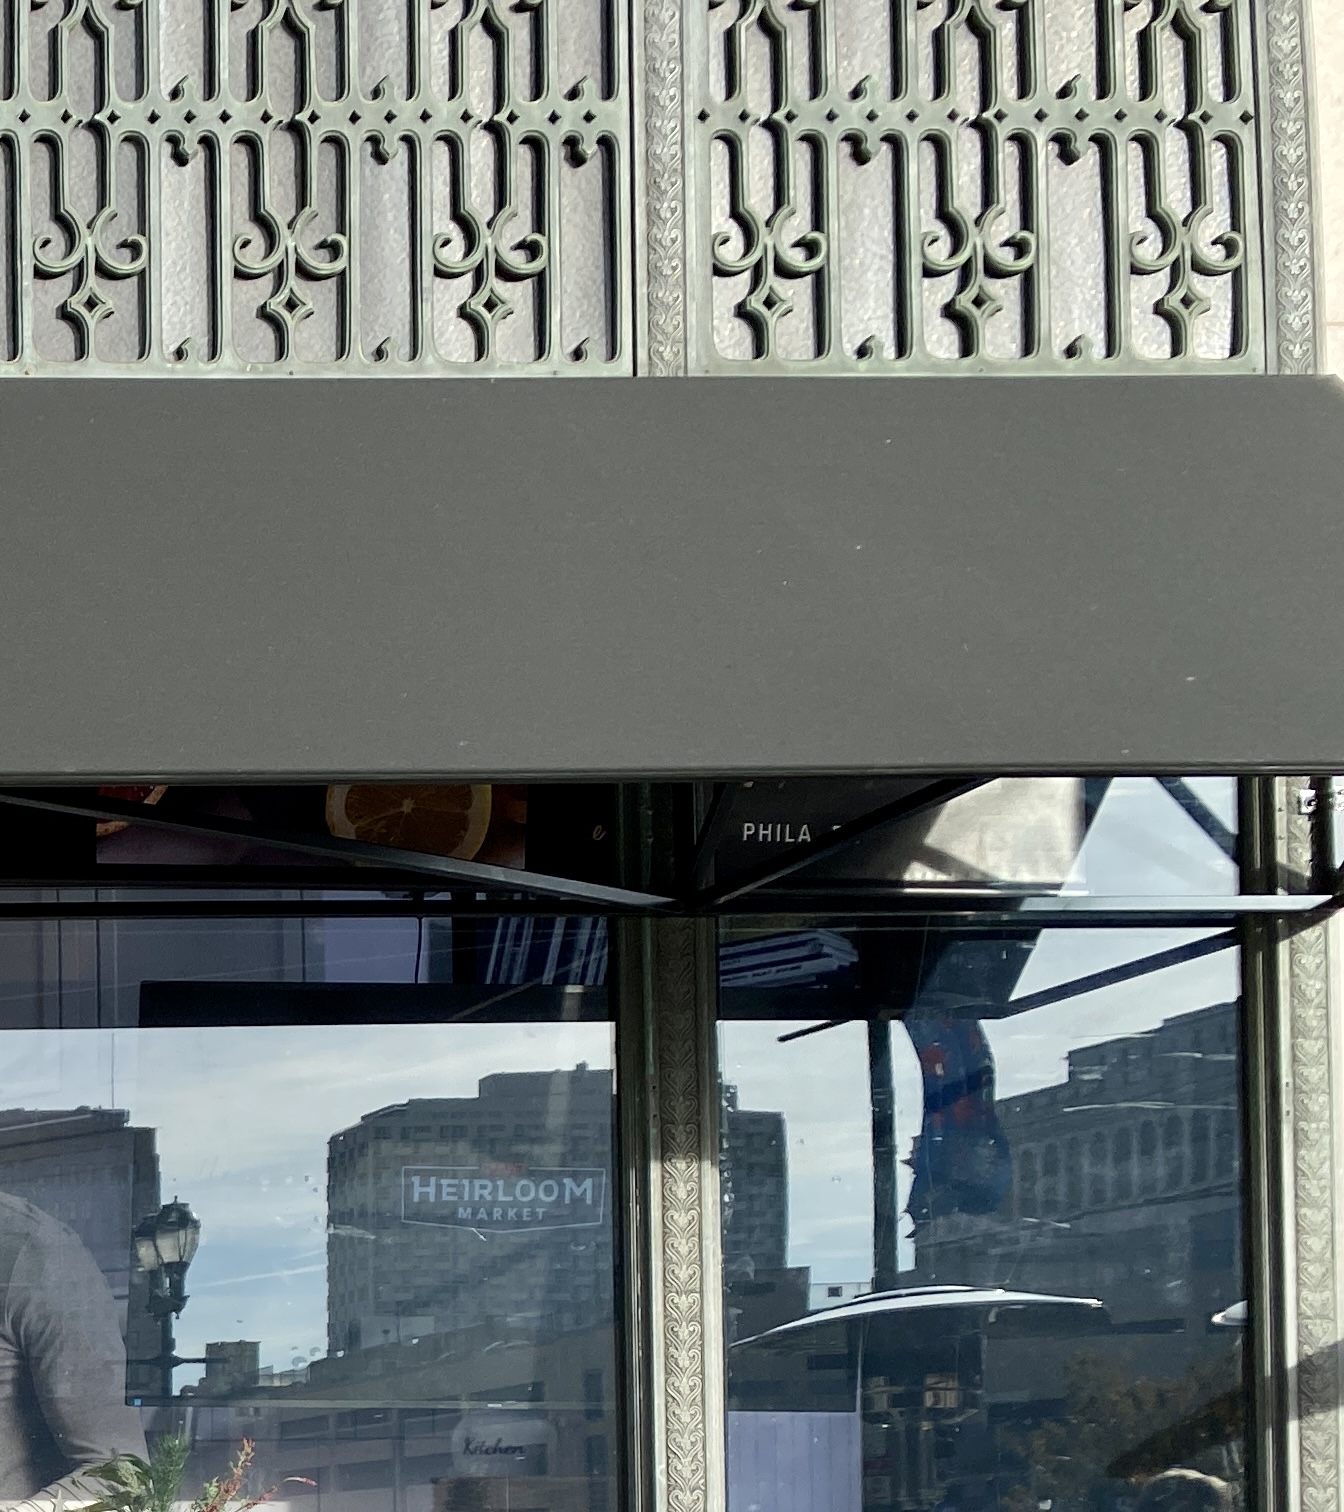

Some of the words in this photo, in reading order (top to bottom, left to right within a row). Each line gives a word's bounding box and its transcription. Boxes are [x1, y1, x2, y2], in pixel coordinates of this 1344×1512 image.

[741, 822, 812, 843] PHILA
[411, 1175, 593, 1205] HEIRLOOM
[457, 1207, 547, 1221] MARKET
[462, 1436, 526, 1456] Kitchen
